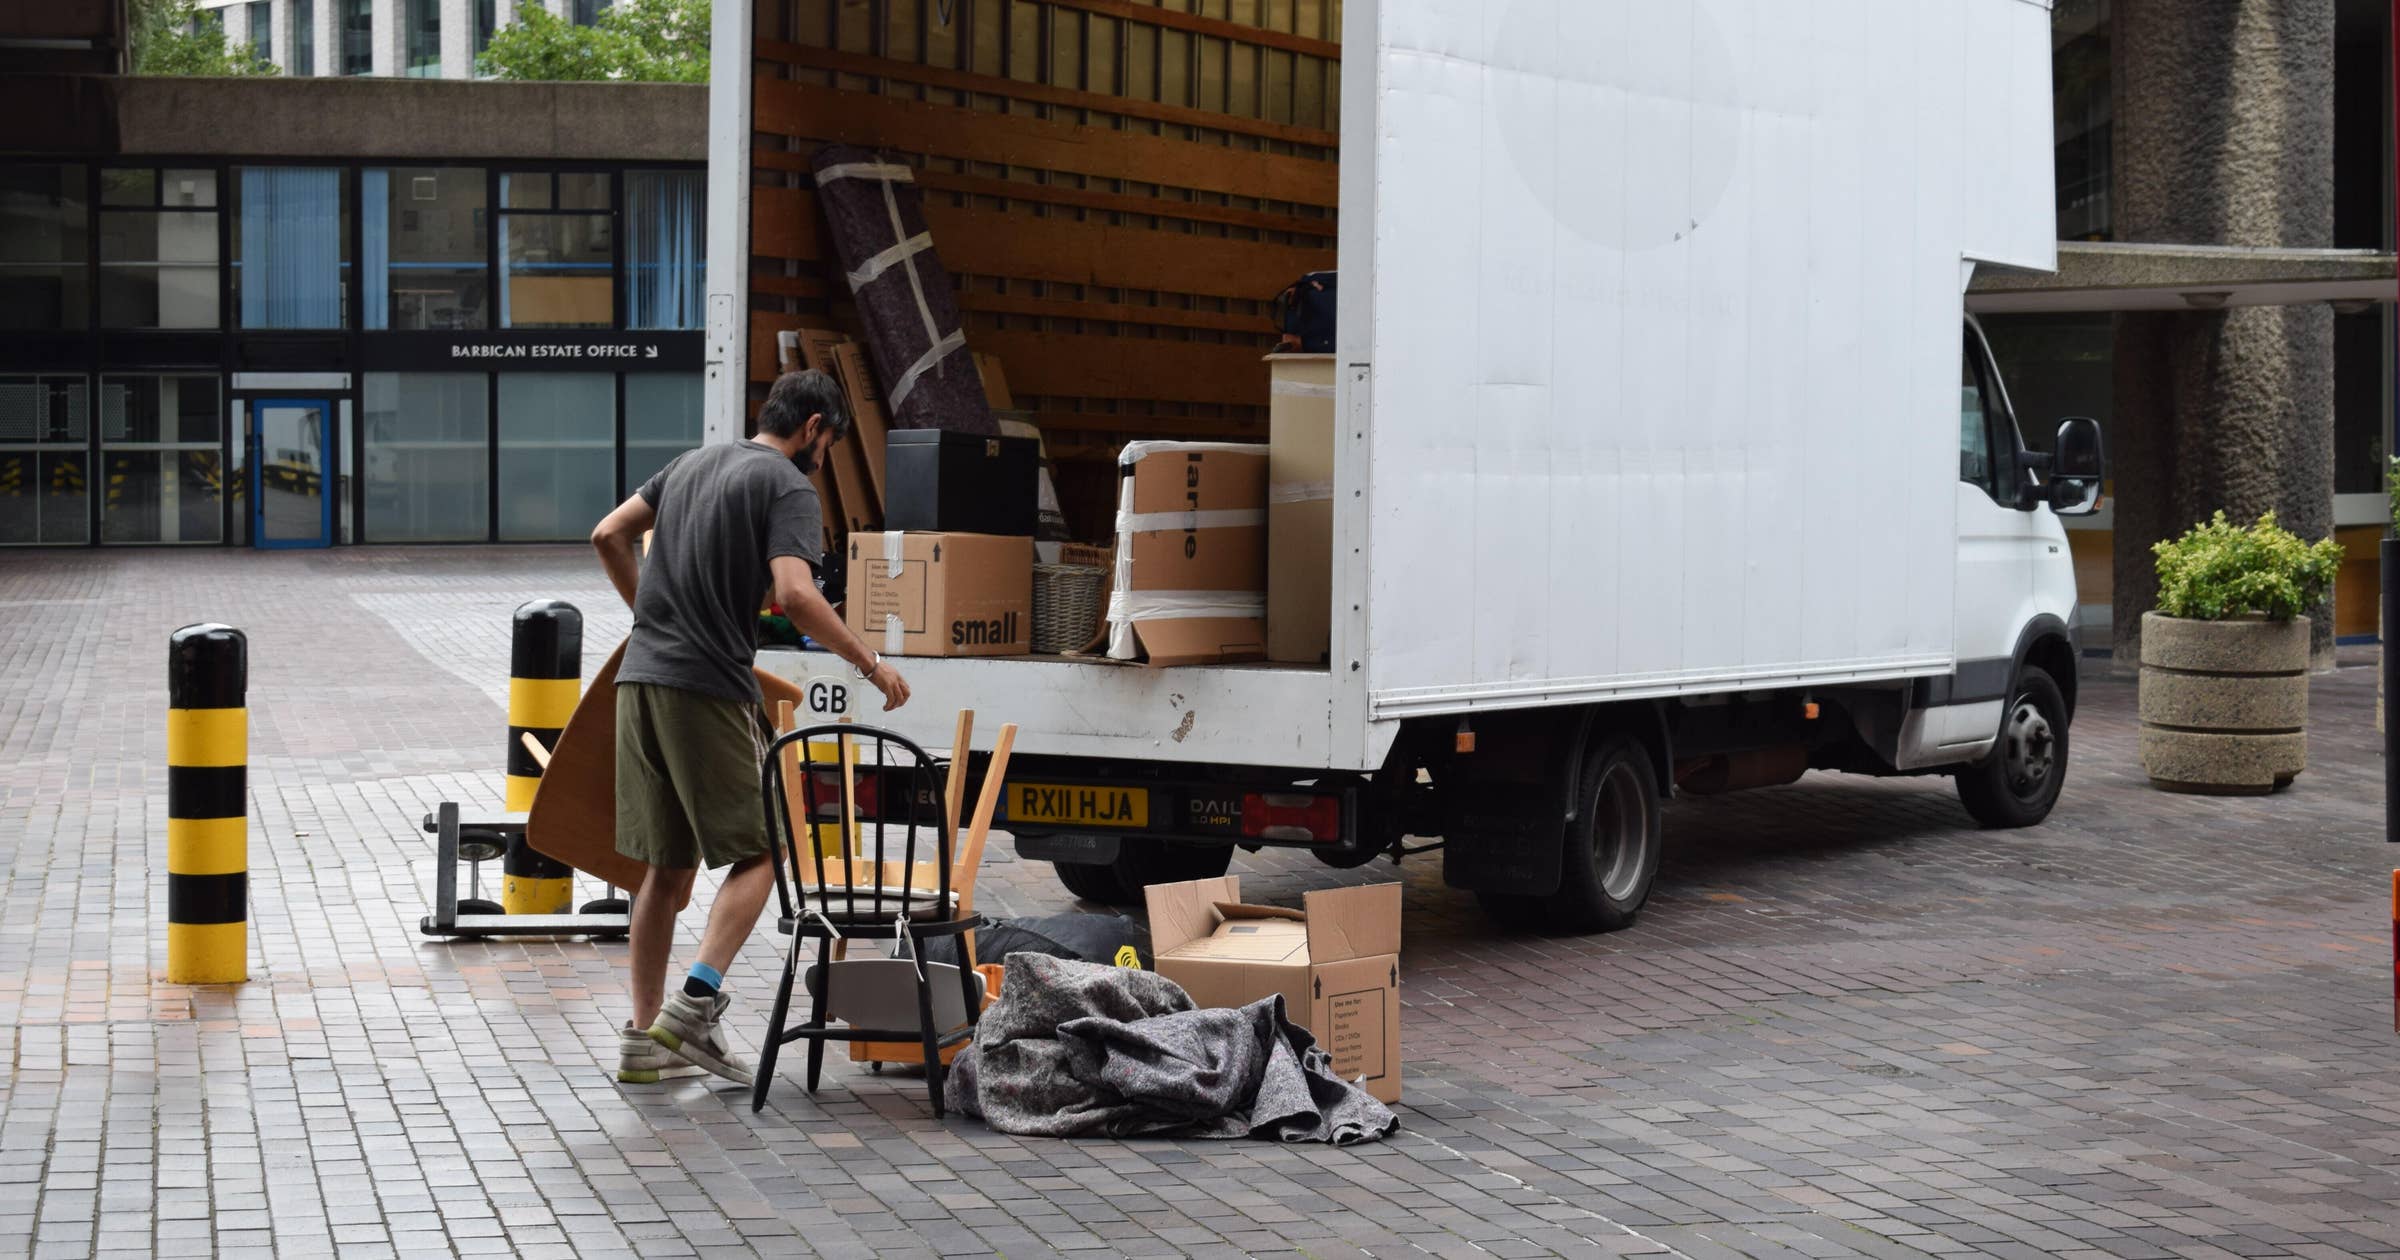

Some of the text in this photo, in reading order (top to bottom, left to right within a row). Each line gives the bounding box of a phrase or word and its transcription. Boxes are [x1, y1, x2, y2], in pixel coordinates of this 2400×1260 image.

[452, 344, 637, 357] BARBICAN ESTATE OFFICE
[952, 611, 1017, 646] small
[810, 682, 847, 713] GB
[1022, 787, 1133, 821] RX11 HJA
